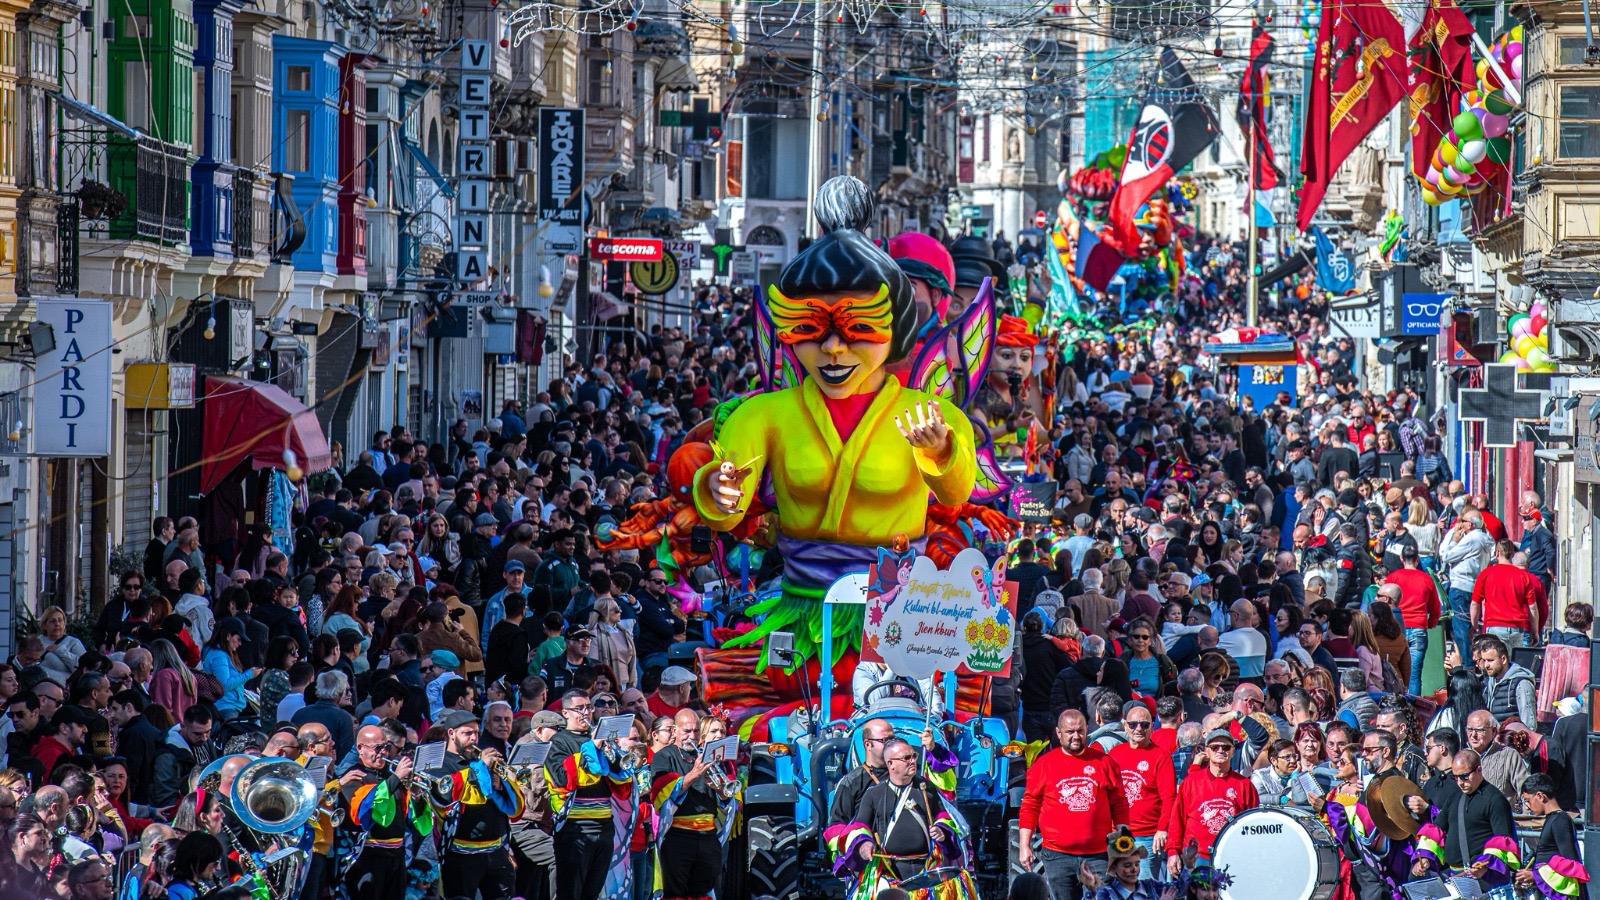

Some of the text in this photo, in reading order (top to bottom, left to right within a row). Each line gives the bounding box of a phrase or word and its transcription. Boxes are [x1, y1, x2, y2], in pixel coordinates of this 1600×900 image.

[463, 44, 485, 278] VETRINA
[550, 111, 575, 208] IMQARET
[466, 294, 491, 304] SHOP
[1407, 321, 1441, 329] OPTICIANS
[59, 308, 86, 448] PARDI
[903, 600, 977, 621] Kuluri bl-ambjent
[914, 621, 958, 638] Jien kburi
[1250, 823, 1284, 835] SONOR
